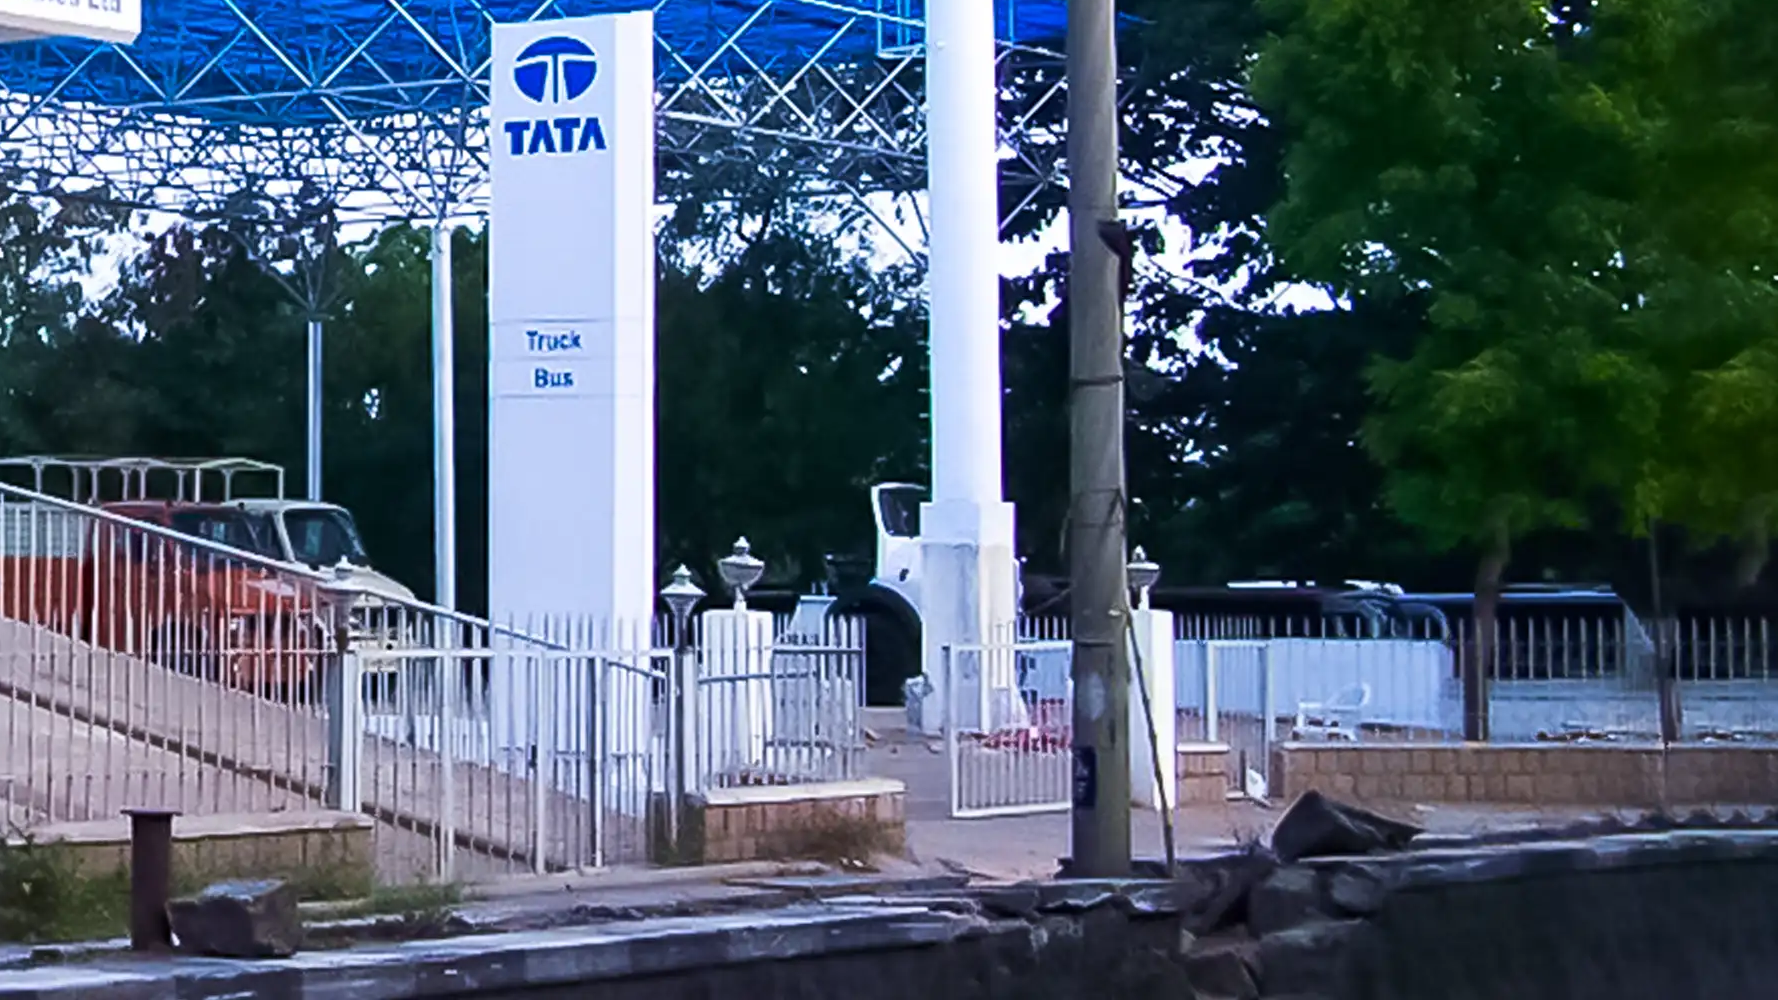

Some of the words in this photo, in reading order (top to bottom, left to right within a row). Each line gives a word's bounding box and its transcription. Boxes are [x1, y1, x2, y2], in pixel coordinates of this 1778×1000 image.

[504, 117, 606, 155] TATA
[526, 330, 582, 351] Truck
[534, 367, 574, 388] Bus
